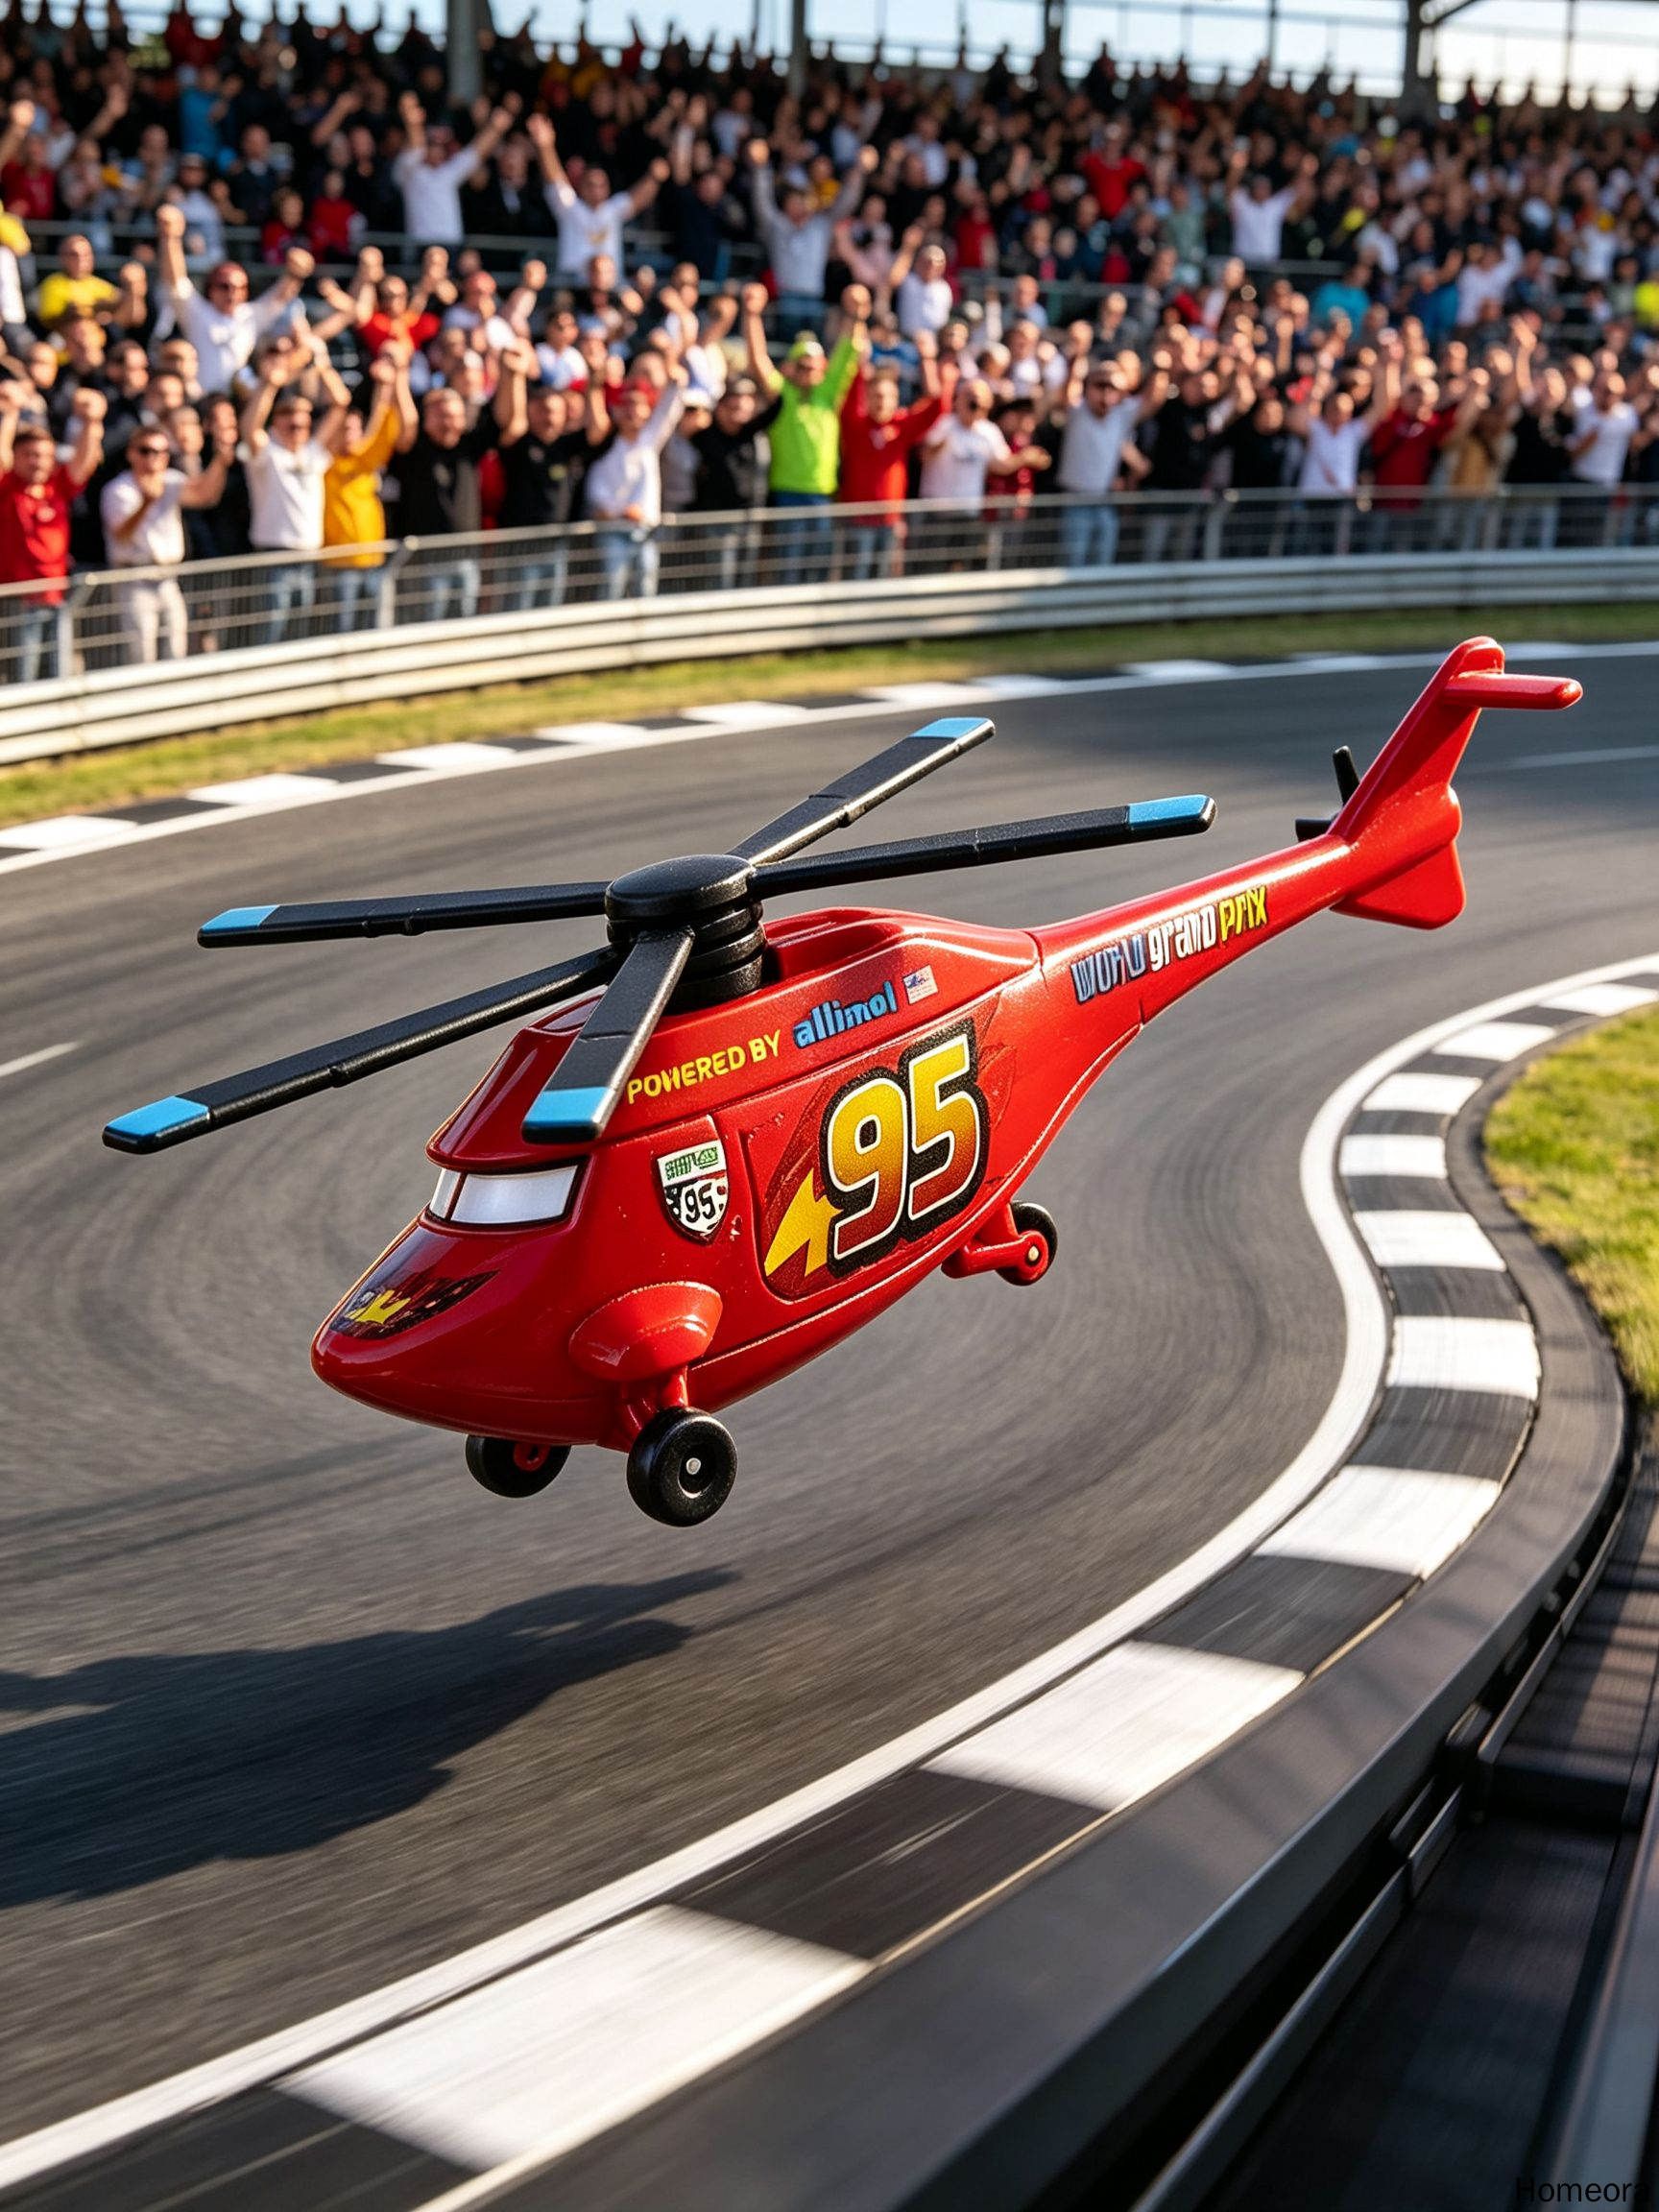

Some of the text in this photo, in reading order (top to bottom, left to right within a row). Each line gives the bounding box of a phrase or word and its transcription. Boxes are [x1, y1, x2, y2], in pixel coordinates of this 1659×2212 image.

[626, 1045, 747, 1105] POWERED
[750, 1028, 782, 1062] BY
[823, 1023, 986, 1269] 95
[685, 1182, 716, 1224] 95
